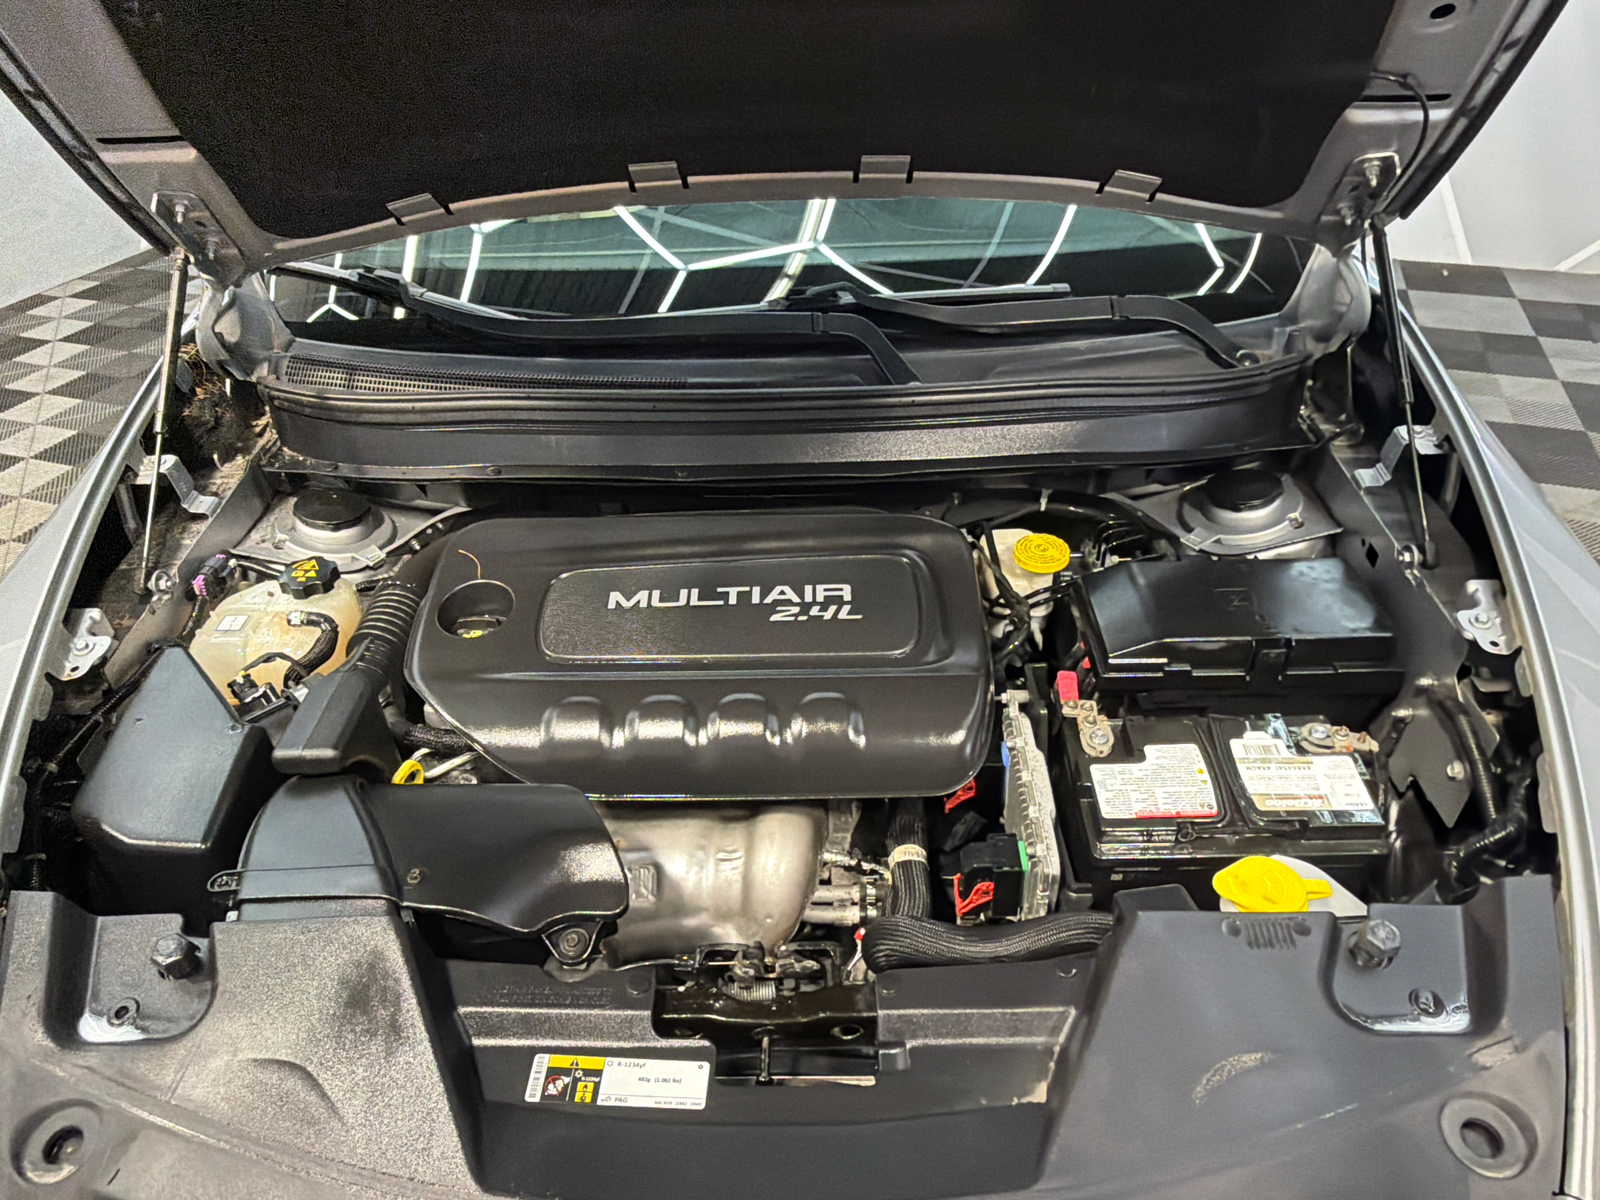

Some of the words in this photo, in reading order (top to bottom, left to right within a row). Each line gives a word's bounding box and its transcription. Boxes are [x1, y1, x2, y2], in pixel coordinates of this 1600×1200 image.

[607, 584, 852, 609] MULTIAIR
[769, 604, 863, 621] 2.4L
[1265, 798, 1323, 808] ACDelco
[617, 1061, 646, 1069] R-1234yf
